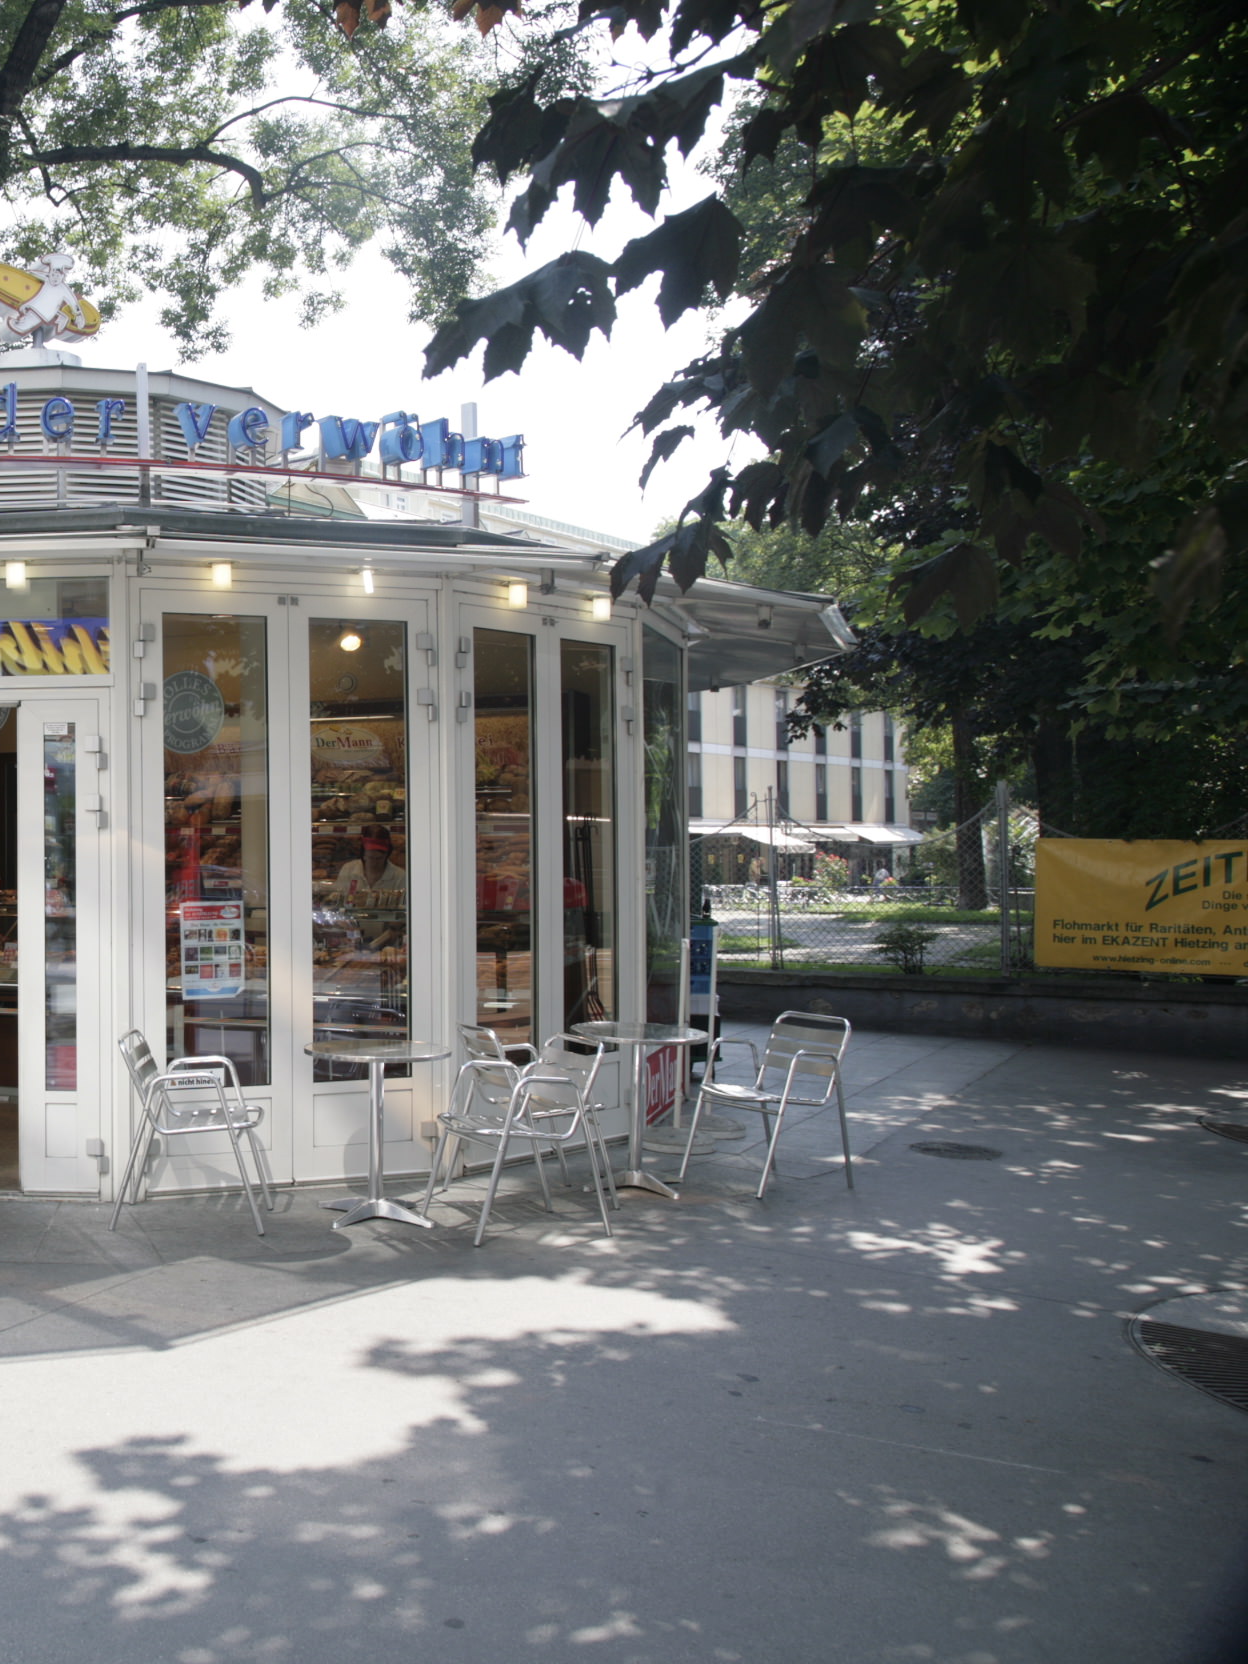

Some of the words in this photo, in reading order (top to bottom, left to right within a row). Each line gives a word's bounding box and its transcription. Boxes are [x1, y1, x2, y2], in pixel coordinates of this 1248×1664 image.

[173, 401, 528, 483] verwöhnt
[164, 677, 212, 698] OLLES
[1222, 891, 1242, 900] Die
[1201, 900, 1238, 912] Dinge
[1053, 919, 1120, 932] Flohmarkt
[1125, 921, 1144, 933] für
[1149, 922, 1217, 937] Raritäten,
[1053, 933, 1076, 944] hier
[1081, 934, 1096, 945] im
[1103, 935, 1168, 948] EKAZENT
[1174, 938, 1229, 951] Hietzing
